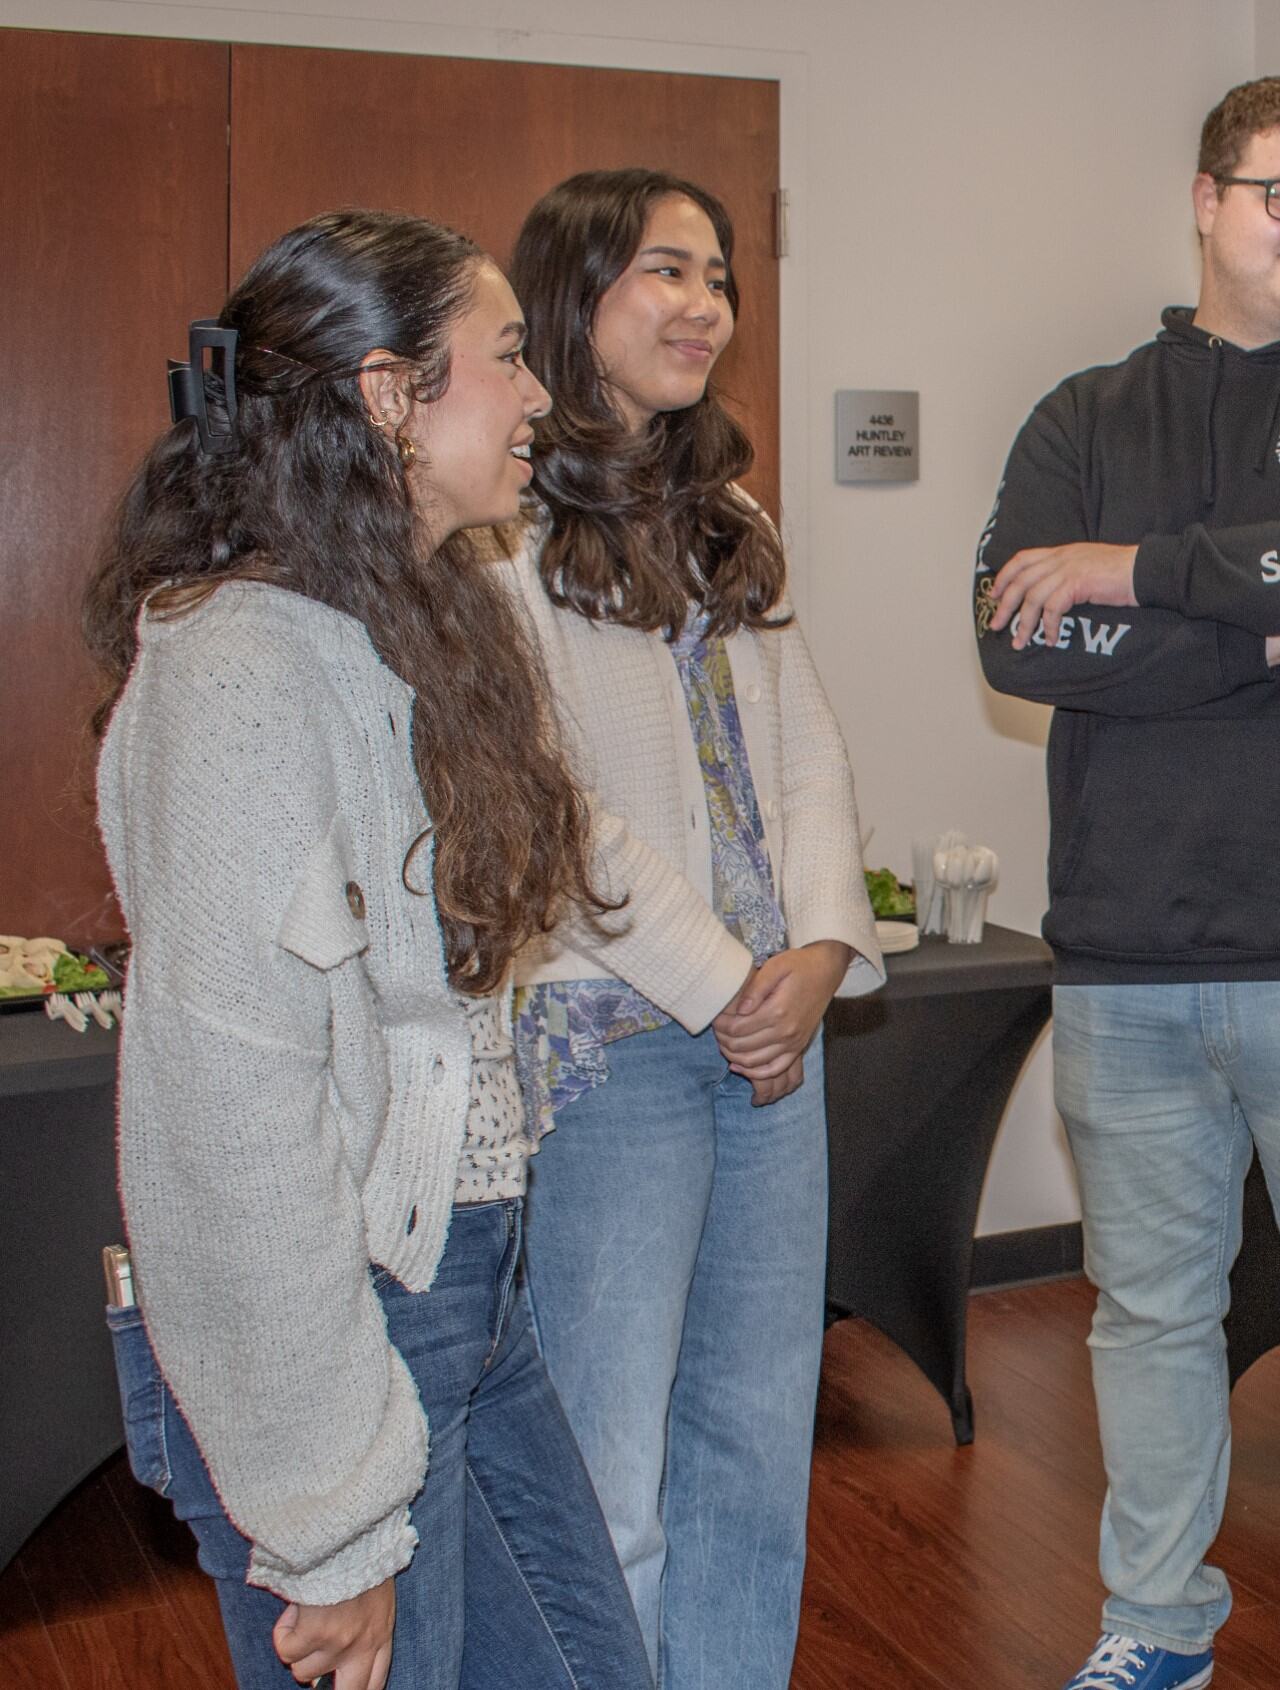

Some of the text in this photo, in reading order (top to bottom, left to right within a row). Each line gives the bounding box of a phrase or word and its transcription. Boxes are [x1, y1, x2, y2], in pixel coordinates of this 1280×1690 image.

[856, 430, 906, 441] HUNTLEY
[848, 445, 913, 457] ART REVIEW
